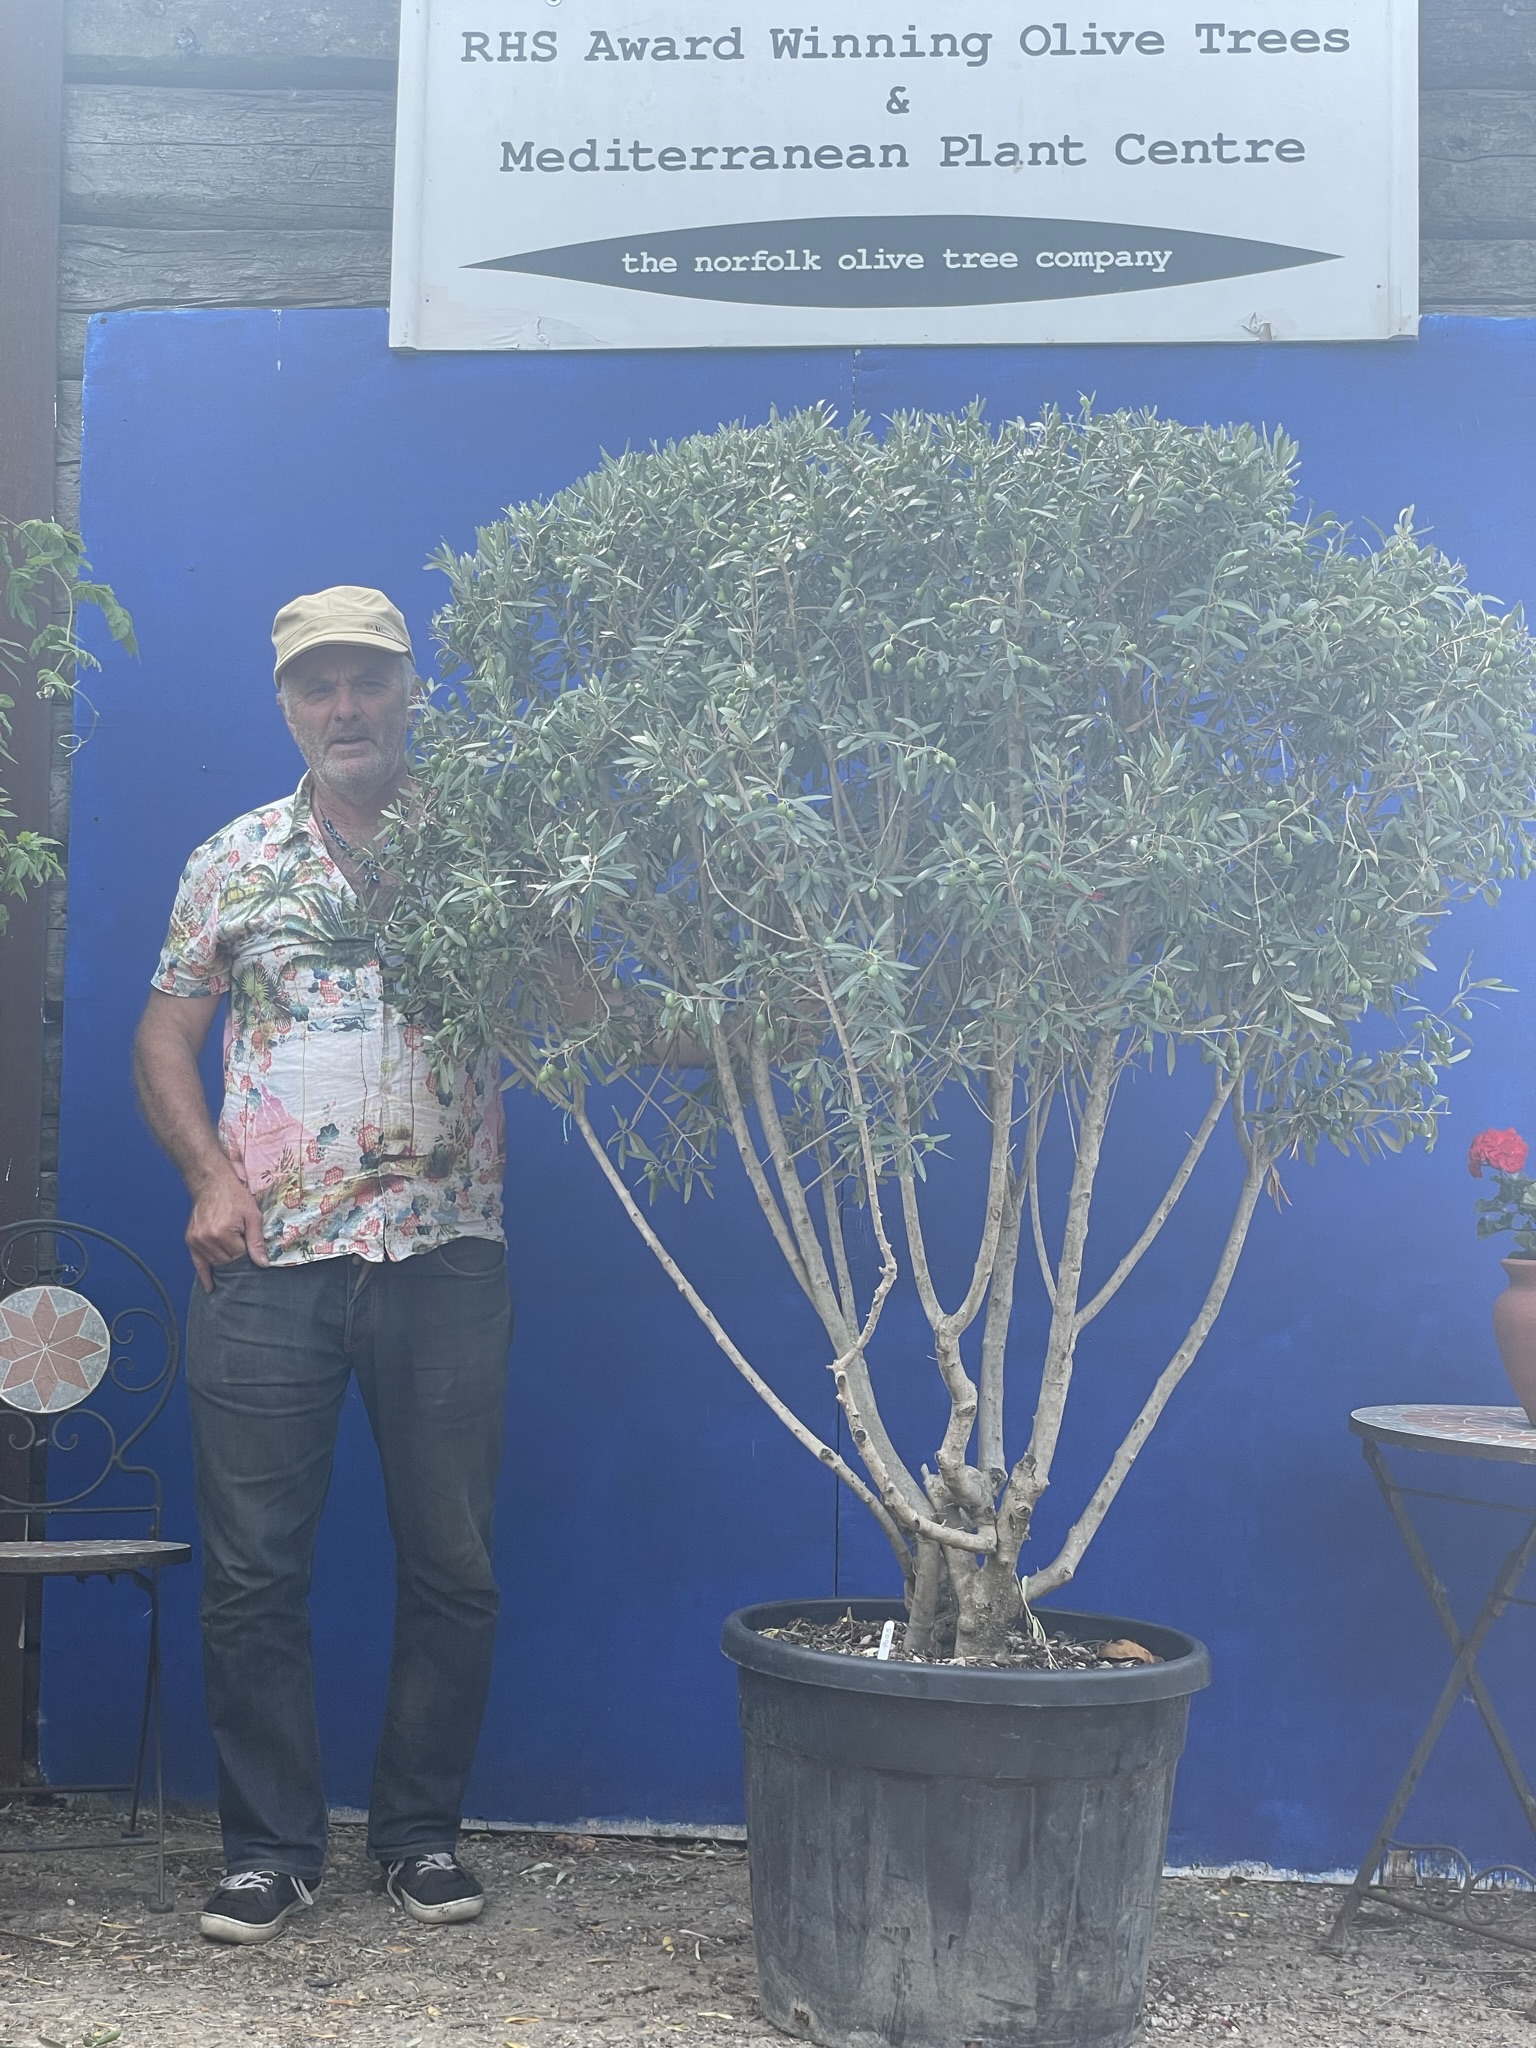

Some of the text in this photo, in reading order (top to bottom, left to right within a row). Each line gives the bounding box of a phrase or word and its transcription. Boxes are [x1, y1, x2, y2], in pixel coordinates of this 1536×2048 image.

[461, 23, 1349, 67] RHS Award Winning Olive Trees
[886, 86, 909, 114] &
[500, 133, 1305, 172] Mediterranean Plant Centre
[621, 248, 1172, 273] the norfolk olive tree company
